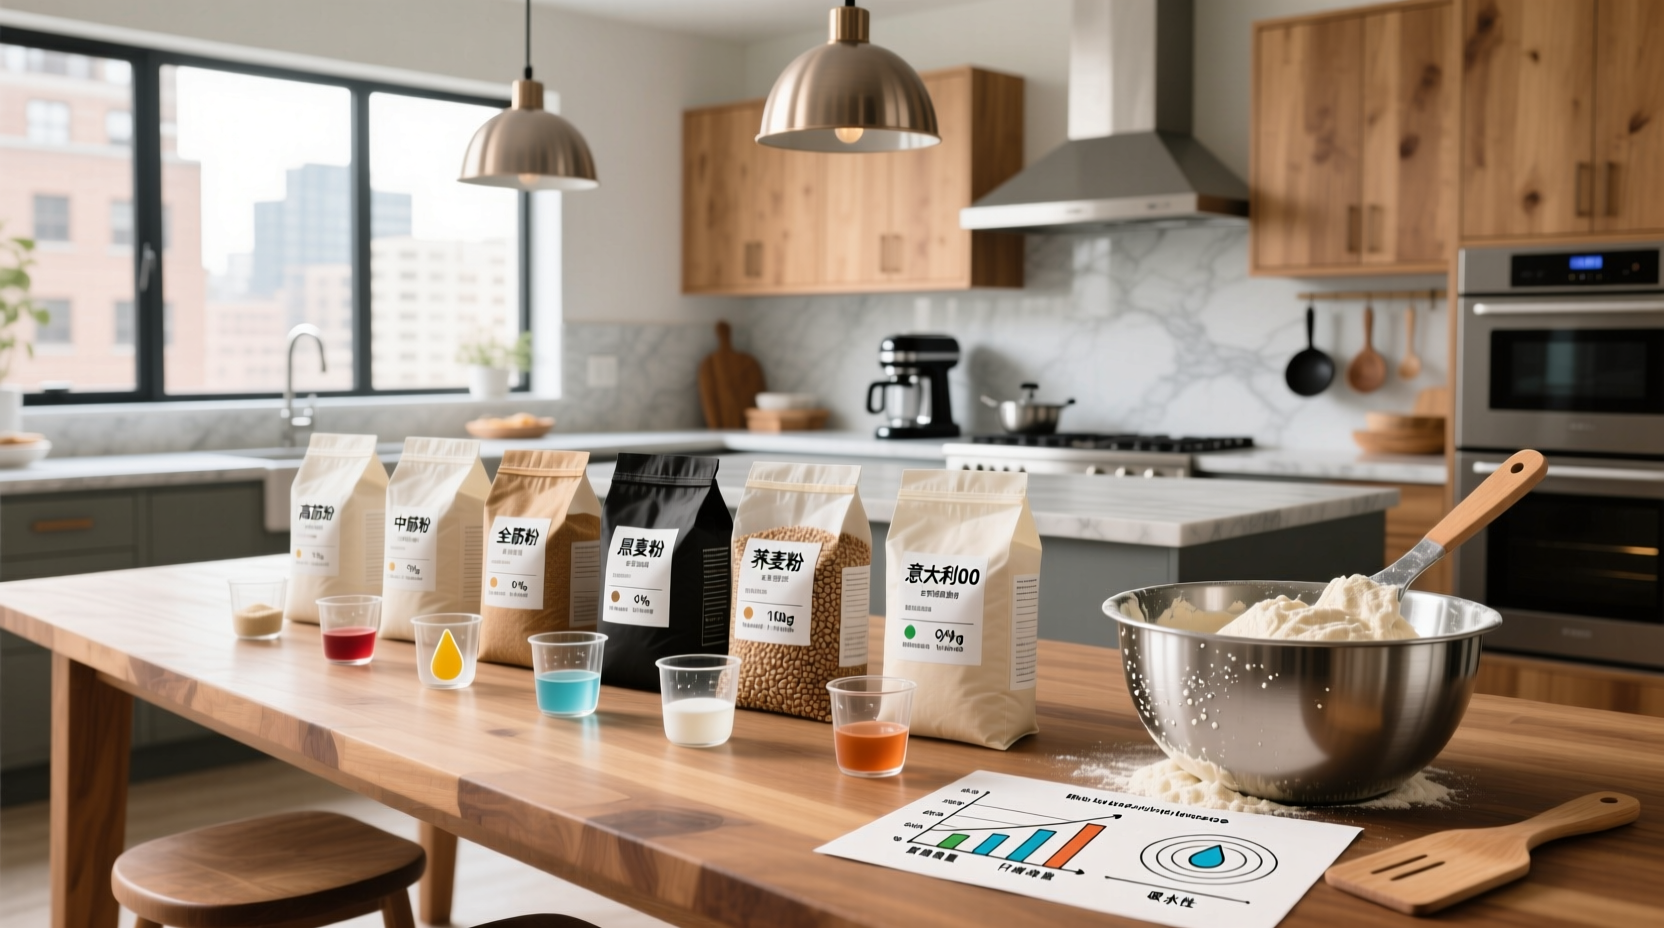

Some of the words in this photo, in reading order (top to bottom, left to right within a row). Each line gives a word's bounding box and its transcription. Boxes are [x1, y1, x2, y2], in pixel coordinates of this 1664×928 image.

[751, 548, 805, 572] 荞麦粉
[904, 562, 980, 586] 意大利00
[634, 594, 651, 607] 0%
